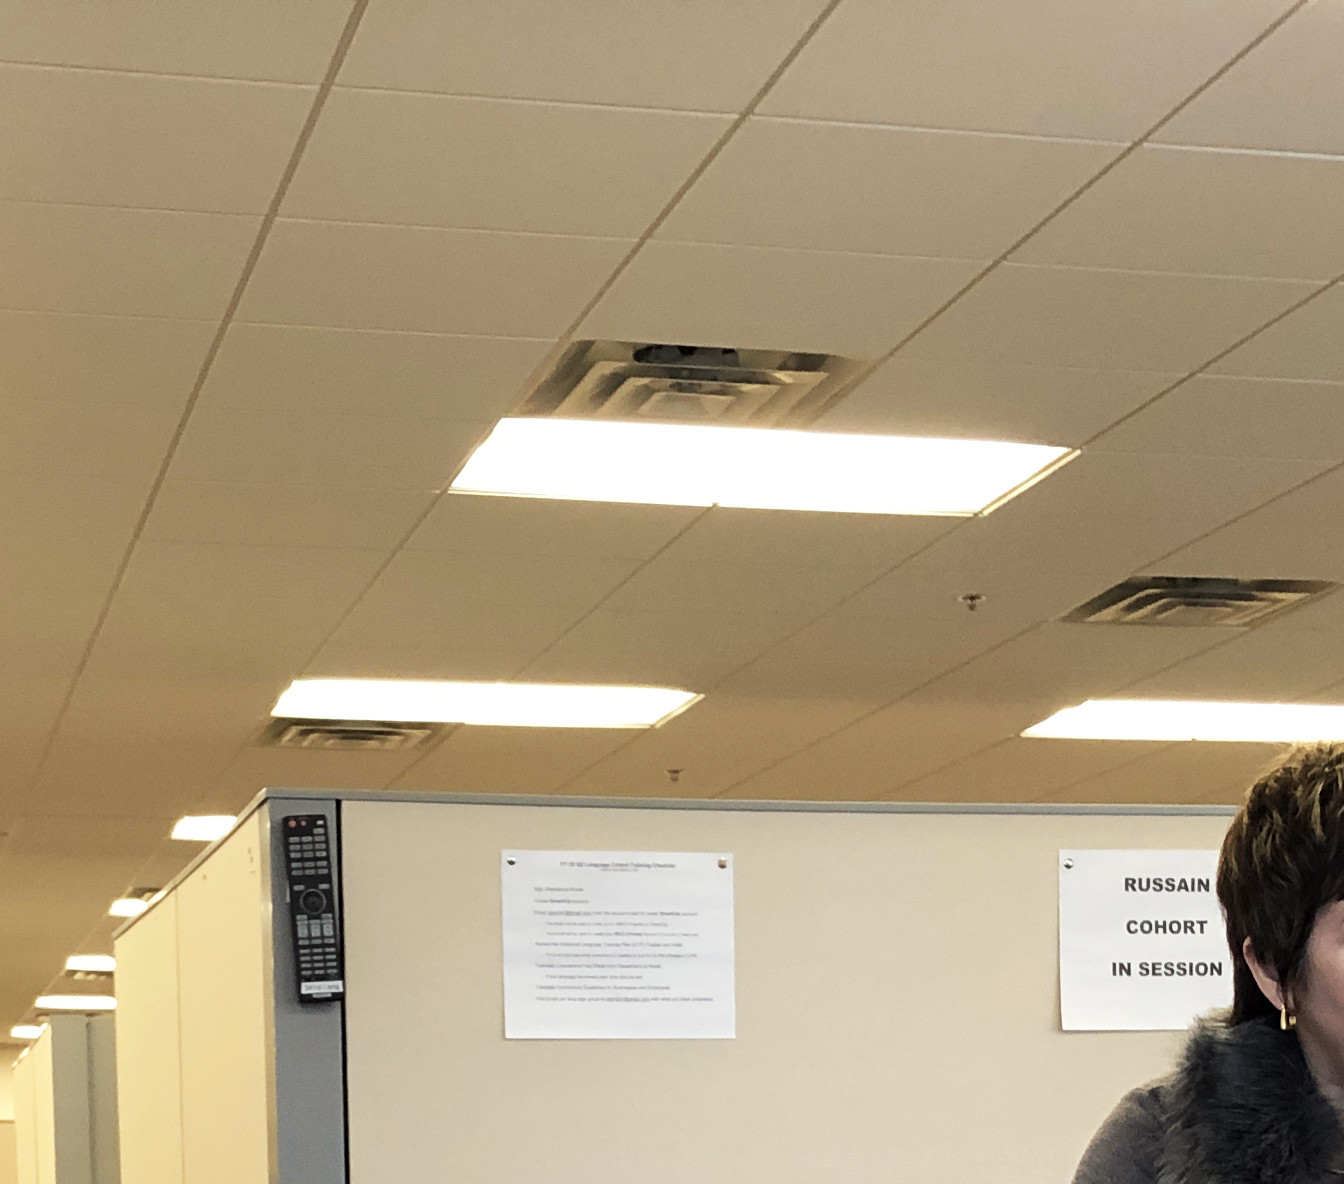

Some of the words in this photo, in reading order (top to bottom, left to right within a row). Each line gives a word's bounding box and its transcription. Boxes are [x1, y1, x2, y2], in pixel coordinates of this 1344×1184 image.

[1125, 877, 1210, 892] RUSSAIN
[1126, 920, 1208, 934] COHORT
[1112, 962, 1131, 977] IN
[1138, 962, 1223, 977] SESSION
